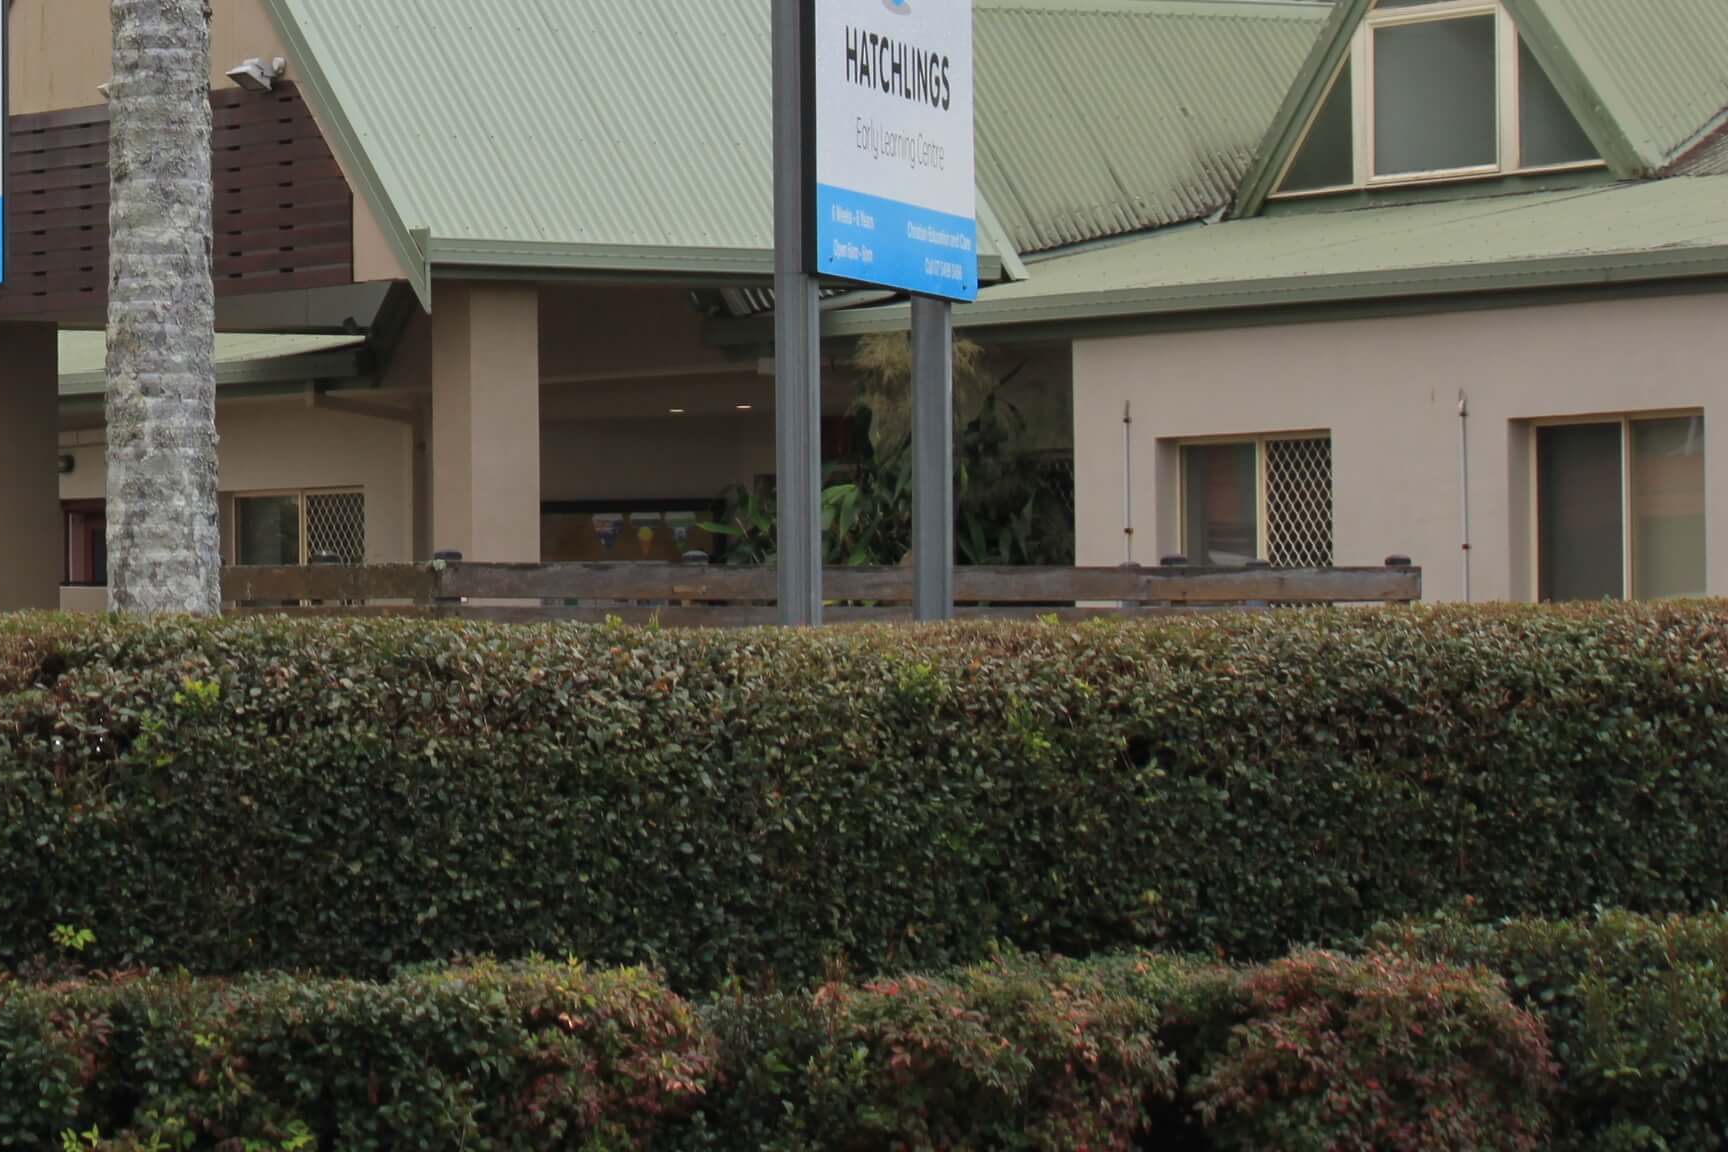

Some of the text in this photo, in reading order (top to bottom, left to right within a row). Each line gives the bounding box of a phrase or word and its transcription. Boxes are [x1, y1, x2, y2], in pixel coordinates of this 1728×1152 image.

[846, 25, 950, 111] HATCHLINGS
[856, 117, 944, 170] Early Learning Centre
